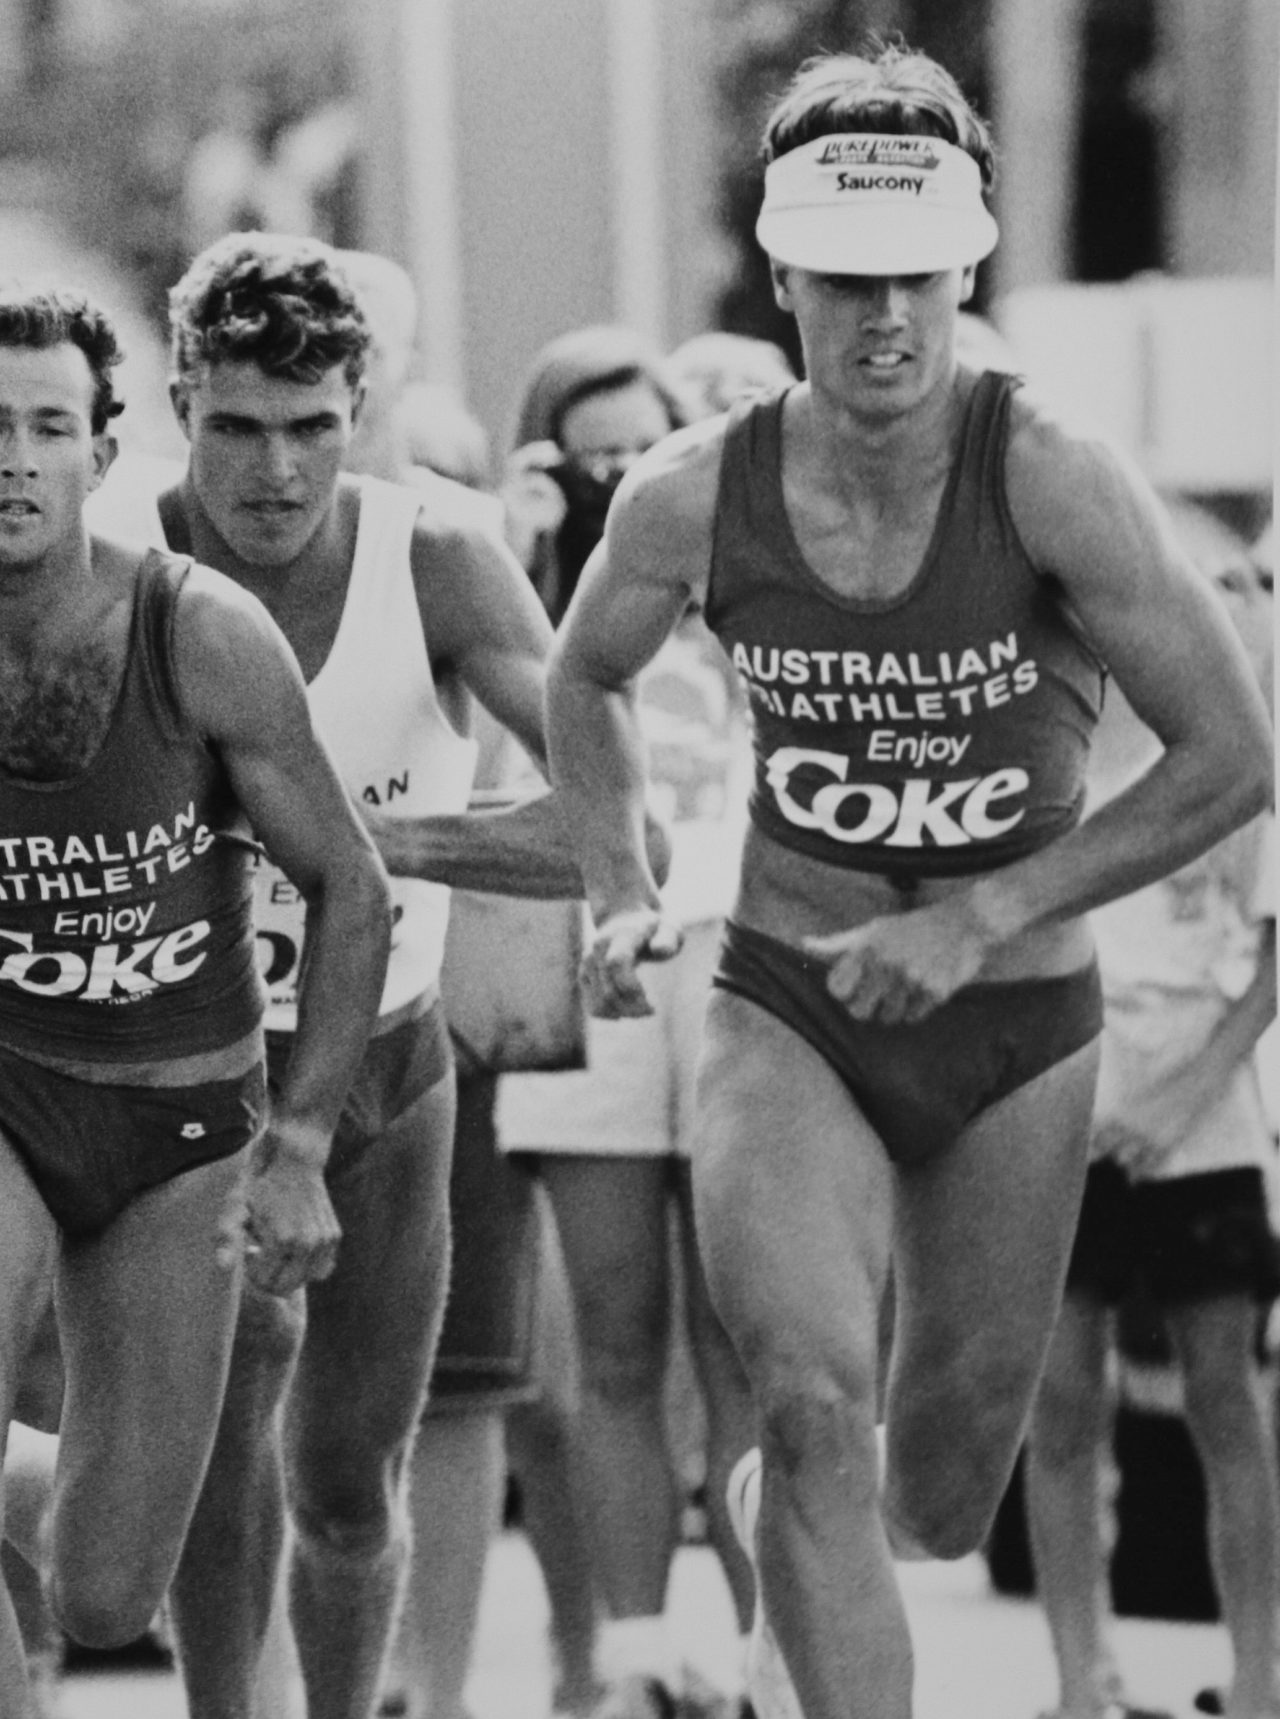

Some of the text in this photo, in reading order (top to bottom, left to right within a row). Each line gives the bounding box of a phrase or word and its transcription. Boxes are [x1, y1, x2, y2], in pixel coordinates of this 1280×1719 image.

[837, 172, 924, 195] Saucony
[732, 631, 1019, 686] AUSTRALIAN
[748, 660, 1039, 722] RIATHLETES
[867, 729, 972, 768] Enjoy
[765, 746, 1031, 848] Coke
[53, 902, 157, 941] Enjoy
